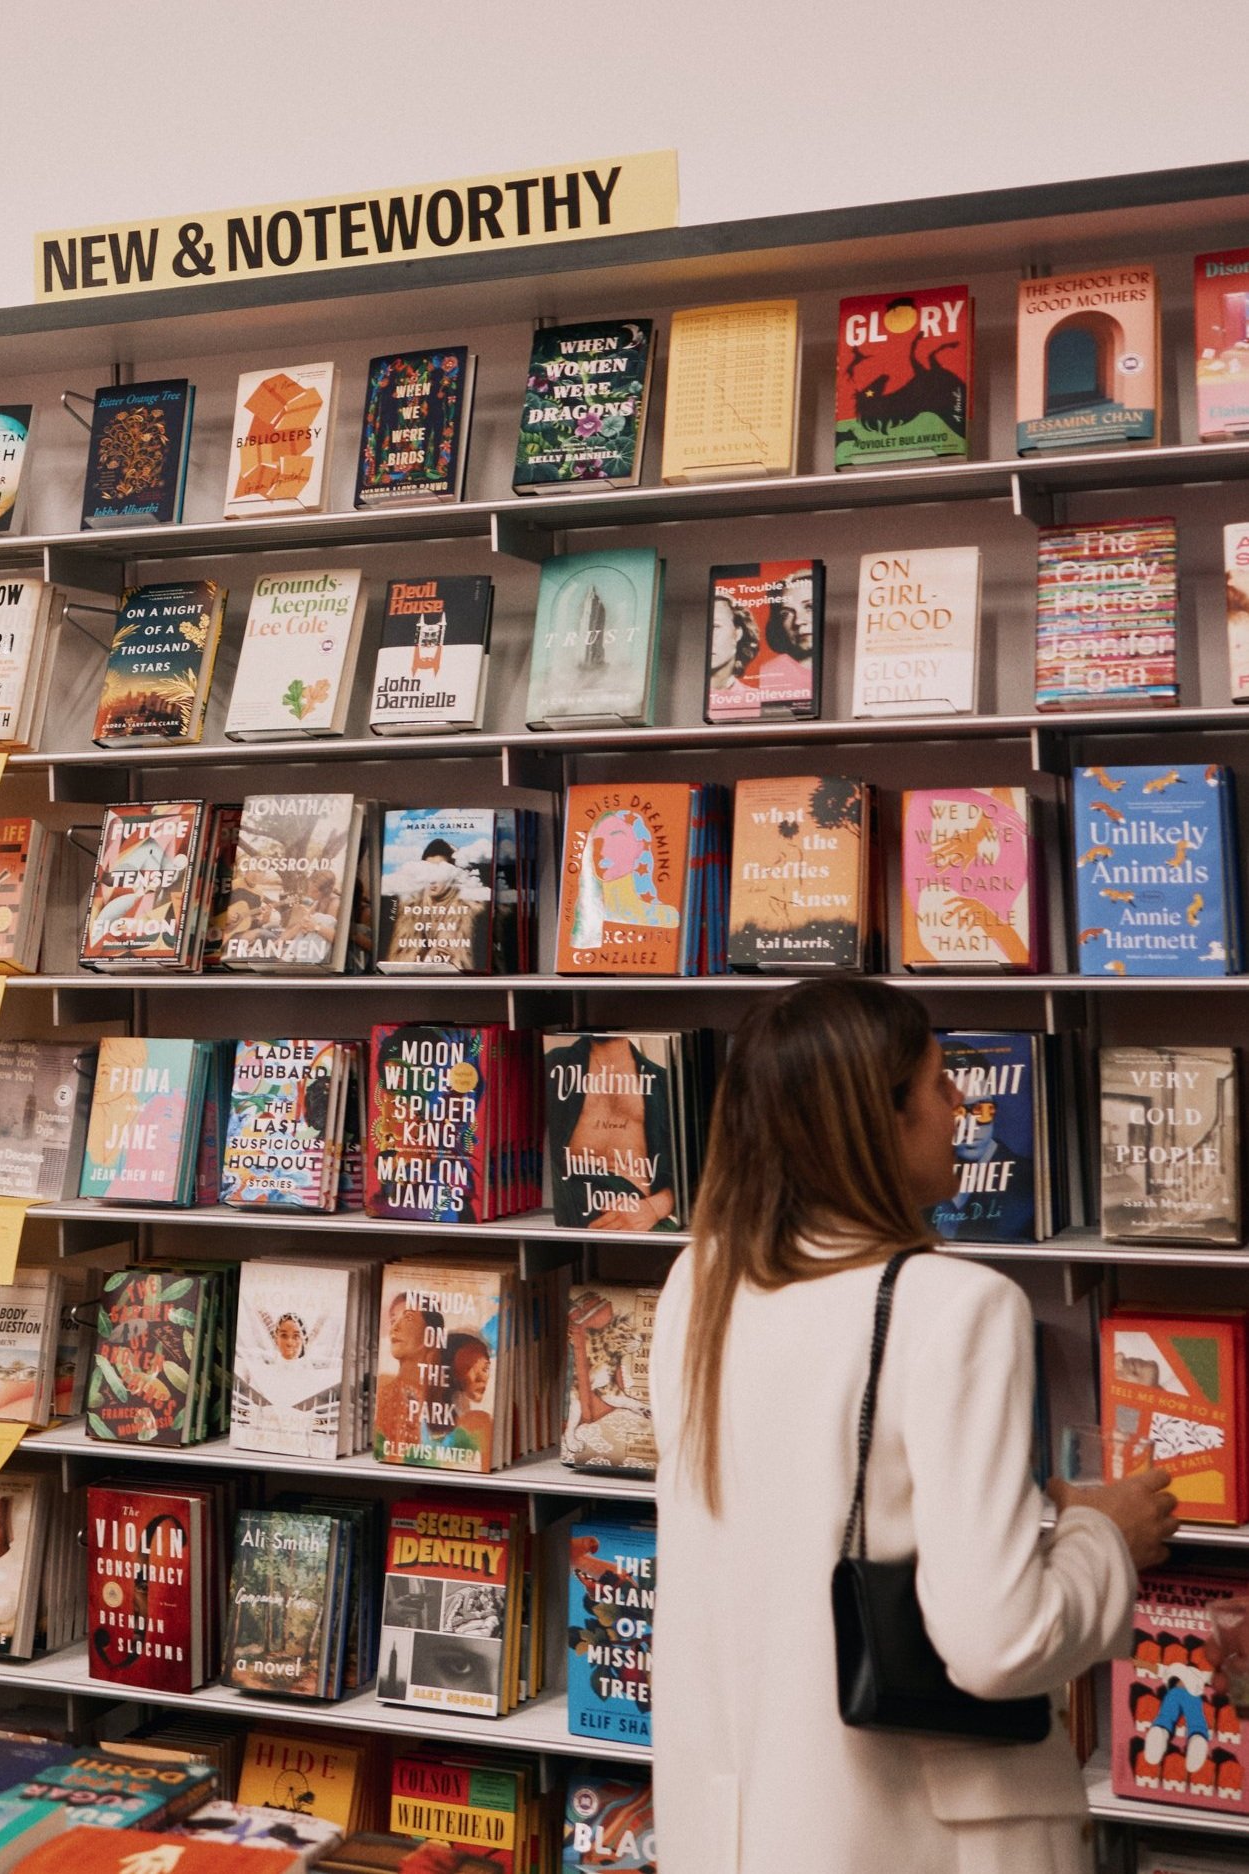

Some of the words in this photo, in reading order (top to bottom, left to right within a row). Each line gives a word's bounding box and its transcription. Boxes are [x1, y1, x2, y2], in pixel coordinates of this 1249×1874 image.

[43, 228, 159, 293] NEW
[171, 222, 216, 278] &
[227, 167, 622, 272] NOTEWORTHY
[1024, 284, 1049, 299] THE
[1055, 275, 1115, 295] SCHOOL
[1120, 272, 1149, 286] FOR
[1026, 298, 1071, 314] GOOD
[1076, 288, 1146, 308] MOTHERS
[846, 300, 963, 347] GLORY
[559, 336, 619, 354] WHEN
[545, 358, 628, 377] WOMEN
[98, 395, 124, 409] Bitter
[126, 392, 157, 405] Orange
[160, 389, 181, 401] Tree
[396, 382, 430, 397] WHEN
[552, 381, 612, 399] WERE
[403, 407, 420, 420] WE
[528, 403, 633, 424] DRAGONS
[1026, 413, 1097, 434] JESSAMINE
[1101, 410, 1143, 425] CHAN
[236, 427, 322, 448] BIBLIOLEPSY
[391, 427, 425, 443] WERE
[387, 450, 425, 466] BIRDS
[869, 559, 910, 582] ON
[256, 575, 343, 597] Grounds-
[391, 581, 438, 599] Devil
[126, 608, 146, 619] ON
[150, 608, 159, 617] A
[163, 604, 203, 615] NIGHT
[271, 595, 349, 617] keeping
[144, 625, 161, 636] OF
[165, 625, 175, 635] A
[248, 619, 282, 637] Lee
[287, 617, 329, 635] Cole
[865, 608, 952, 634] HOOD
[544, 627, 640, 648] TRUST
[120, 641, 190, 656] THOUSAND
[131, 661, 171, 673] STARS
[377, 677, 421, 694] John
[710, 692, 742, 705] Tove
[745, 687, 811, 702] Ditlevsen
[751, 807, 805, 825] what
[928, 805, 962, 820] WE
[969, 804, 999, 819] DO
[803, 834, 838, 851] the
[915, 828, 980, 845] WHAT
[985, 827, 1014, 843] WE
[1089, 821, 1209, 849] Unlikely
[110, 869, 176, 888] TENSE
[742, 861, 830, 880] fireflies
[1091, 860, 1209, 884] Animals
[915, 878, 951, 892] THE
[960, 876, 1015, 892] DARK
[792, 890, 852, 908] knew
[403, 905, 470, 917] PORTRAIT
[1120, 909, 1181, 926] Annie
[92, 918, 177, 937] FICTION
[414, 921, 432, 932] OF
[437, 921, 457, 932] AN
[226, 937, 327, 961] FRANZEN
[398, 937, 471, 949] UNKNOWN
[755, 938, 780, 950] kai
[782, 937, 830, 949] harris
[937, 936, 991, 952] HART
[1104, 931, 1198, 949] Hartnett
[254, 1045, 314, 1061] LADEE
[401, 1041, 465, 1064] MOON
[110, 1067, 171, 1093] FIONA
[238, 1065, 327, 1080] HUBBARD
[550, 1064, 657, 1101] Vladimir
[1130, 1070, 1199, 1089] VERY
[264, 1102, 293, 1113] THE
[394, 1097, 477, 1123] SPIDER
[1129, 1106, 1202, 1127] COLD
[104, 1123, 158, 1150] JANE
[253, 1119, 303, 1133] LAST
[402, 1123, 457, 1148] KING
[230, 1137, 324, 1150] SUSPICIOUS
[228, 1155, 320, 1171] HOLDOUT
[1116, 1145, 1220, 1166] PEOPLE
[377, 1157, 468, 1185] MARLON
[562, 1147, 609, 1181] Julia
[613, 1148, 661, 1186] May
[388, 1185, 464, 1211] JAMES
[582, 1182, 640, 1216] Jonas
[0, 1307, 28, 1320] BODY
[405, 1290, 478, 1316] NERUDA
[423, 1325, 450, 1351] ON
[417, 1363, 451, 1387] THE
[407, 1397, 458, 1427] PARK
[1111, 1385, 1135, 1398] TELL
[1138, 1391, 1155, 1403] ME
[1159, 1396, 1188, 1411] HOW
[1192, 1405, 1208, 1417] TO
[1212, 1410, 1227, 1422] BE
[417, 1511, 483, 1538] SECRET
[95, 1518, 184, 1560] VIOLIN
[240, 1530, 267, 1550] Ali
[271, 1533, 320, 1554] Smith
[392, 1535, 505, 1576] IDENTITY
[96, 1560, 184, 1587] CONSPIRACY
[1181, 1585, 1234, 1600] TOWN
[99, 1608, 166, 1634] BRENDAN
[616, 1616, 647, 1640] OF
[255, 1741, 339, 1780] HIDE
[396, 1763, 464, 1798] COLSON
[397, 1802, 505, 1842] WHITEHEAD
